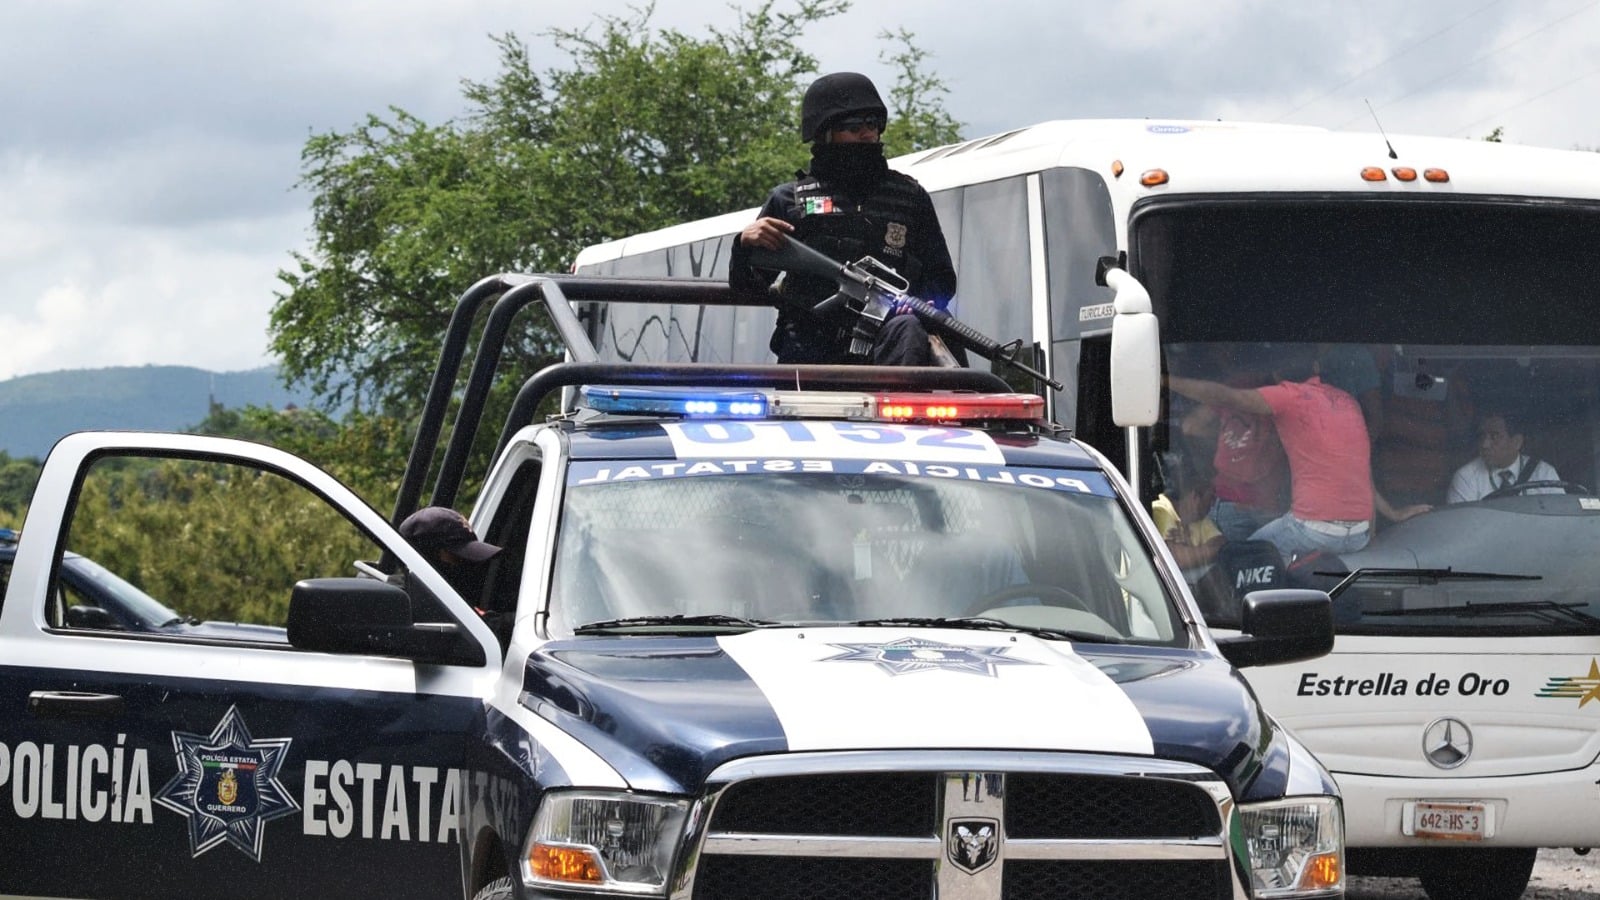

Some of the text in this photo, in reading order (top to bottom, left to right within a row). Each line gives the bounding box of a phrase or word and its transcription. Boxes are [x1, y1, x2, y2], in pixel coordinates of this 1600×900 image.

[1236, 565, 1275, 588] NIKE
[1297, 672, 1510, 696] Estrella de Oro
[230, 756, 258, 764] ESTATAL
[207, 804, 246, 812] GUERRERO
[1420, 813, 1479, 831] 642-HS-3
